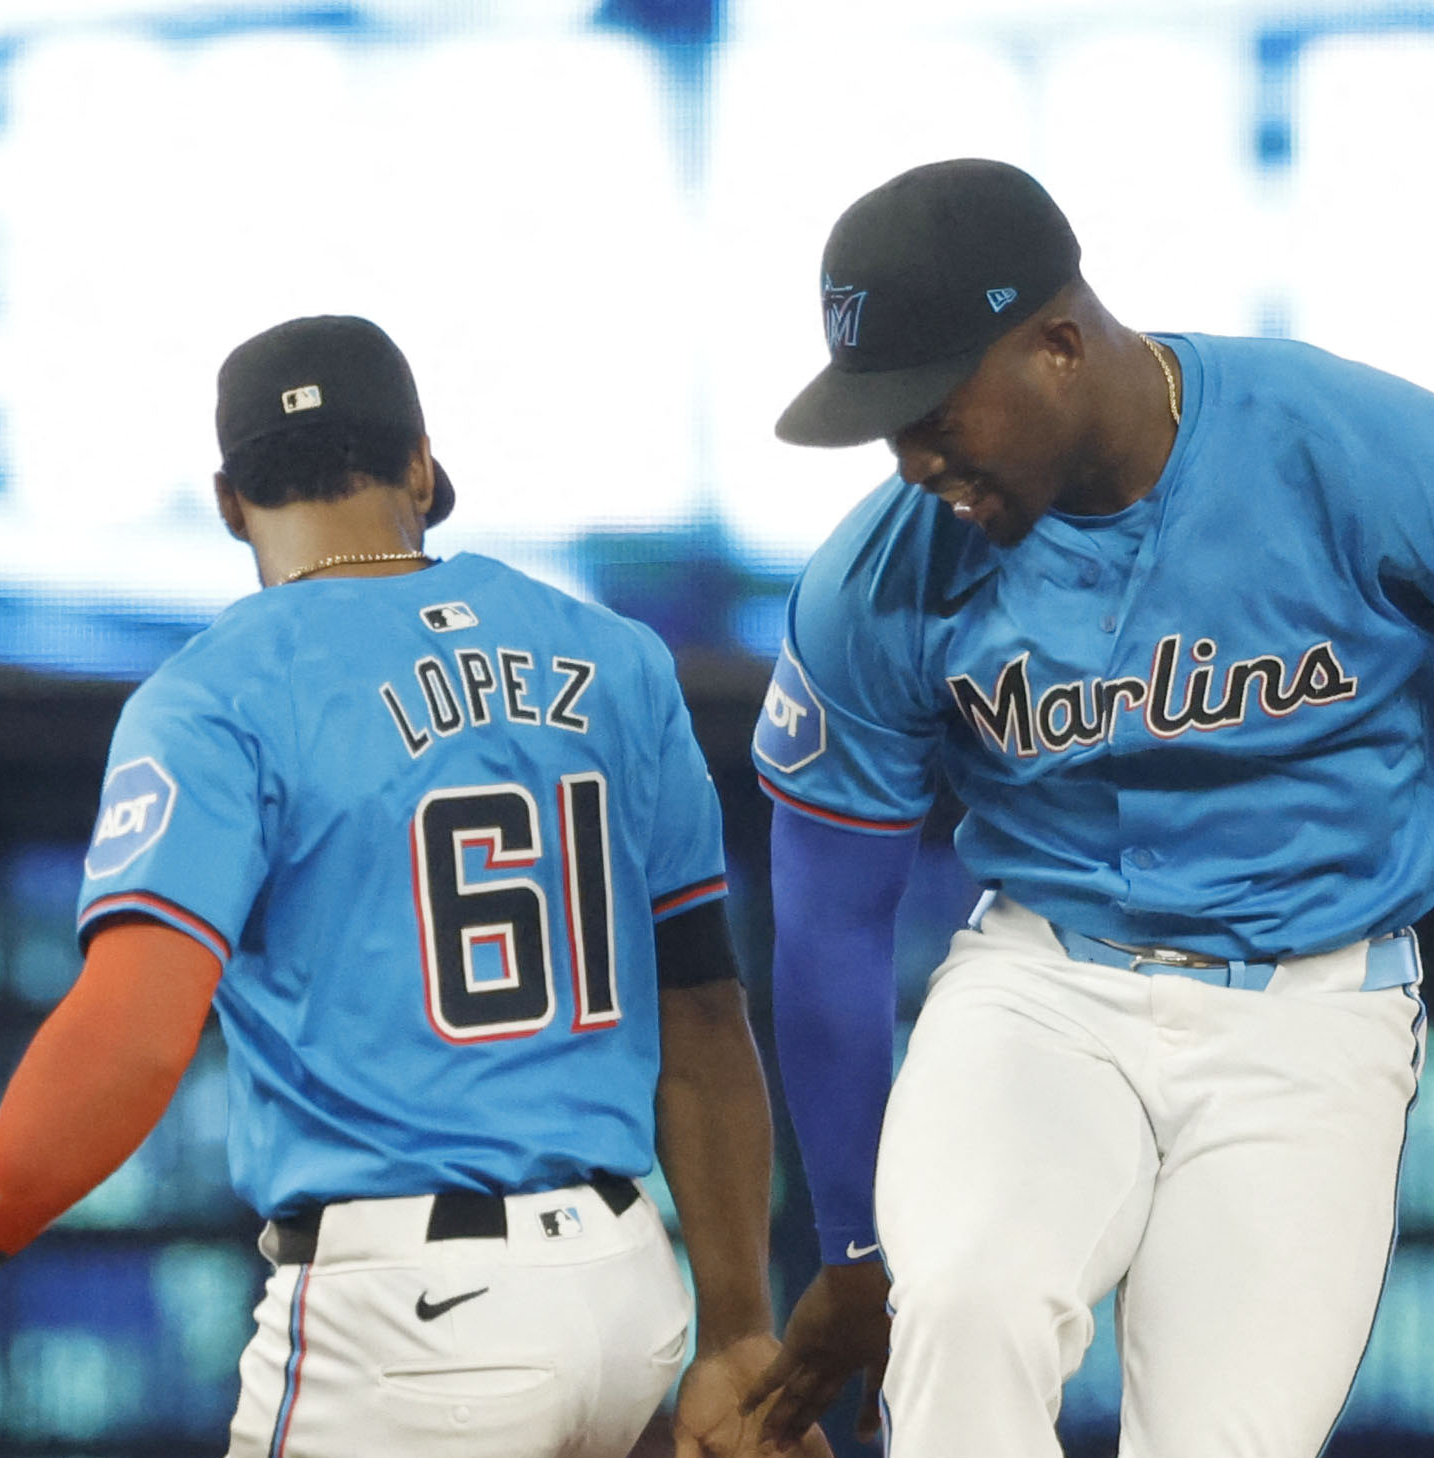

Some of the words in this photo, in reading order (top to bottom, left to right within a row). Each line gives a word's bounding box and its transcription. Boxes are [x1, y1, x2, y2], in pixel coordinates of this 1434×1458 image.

[380, 648, 596, 759] LOPEZ
[946, 633, 1358, 757] Marlins
[94, 793, 158, 847] ADT
[410, 771, 622, 1046] 61
